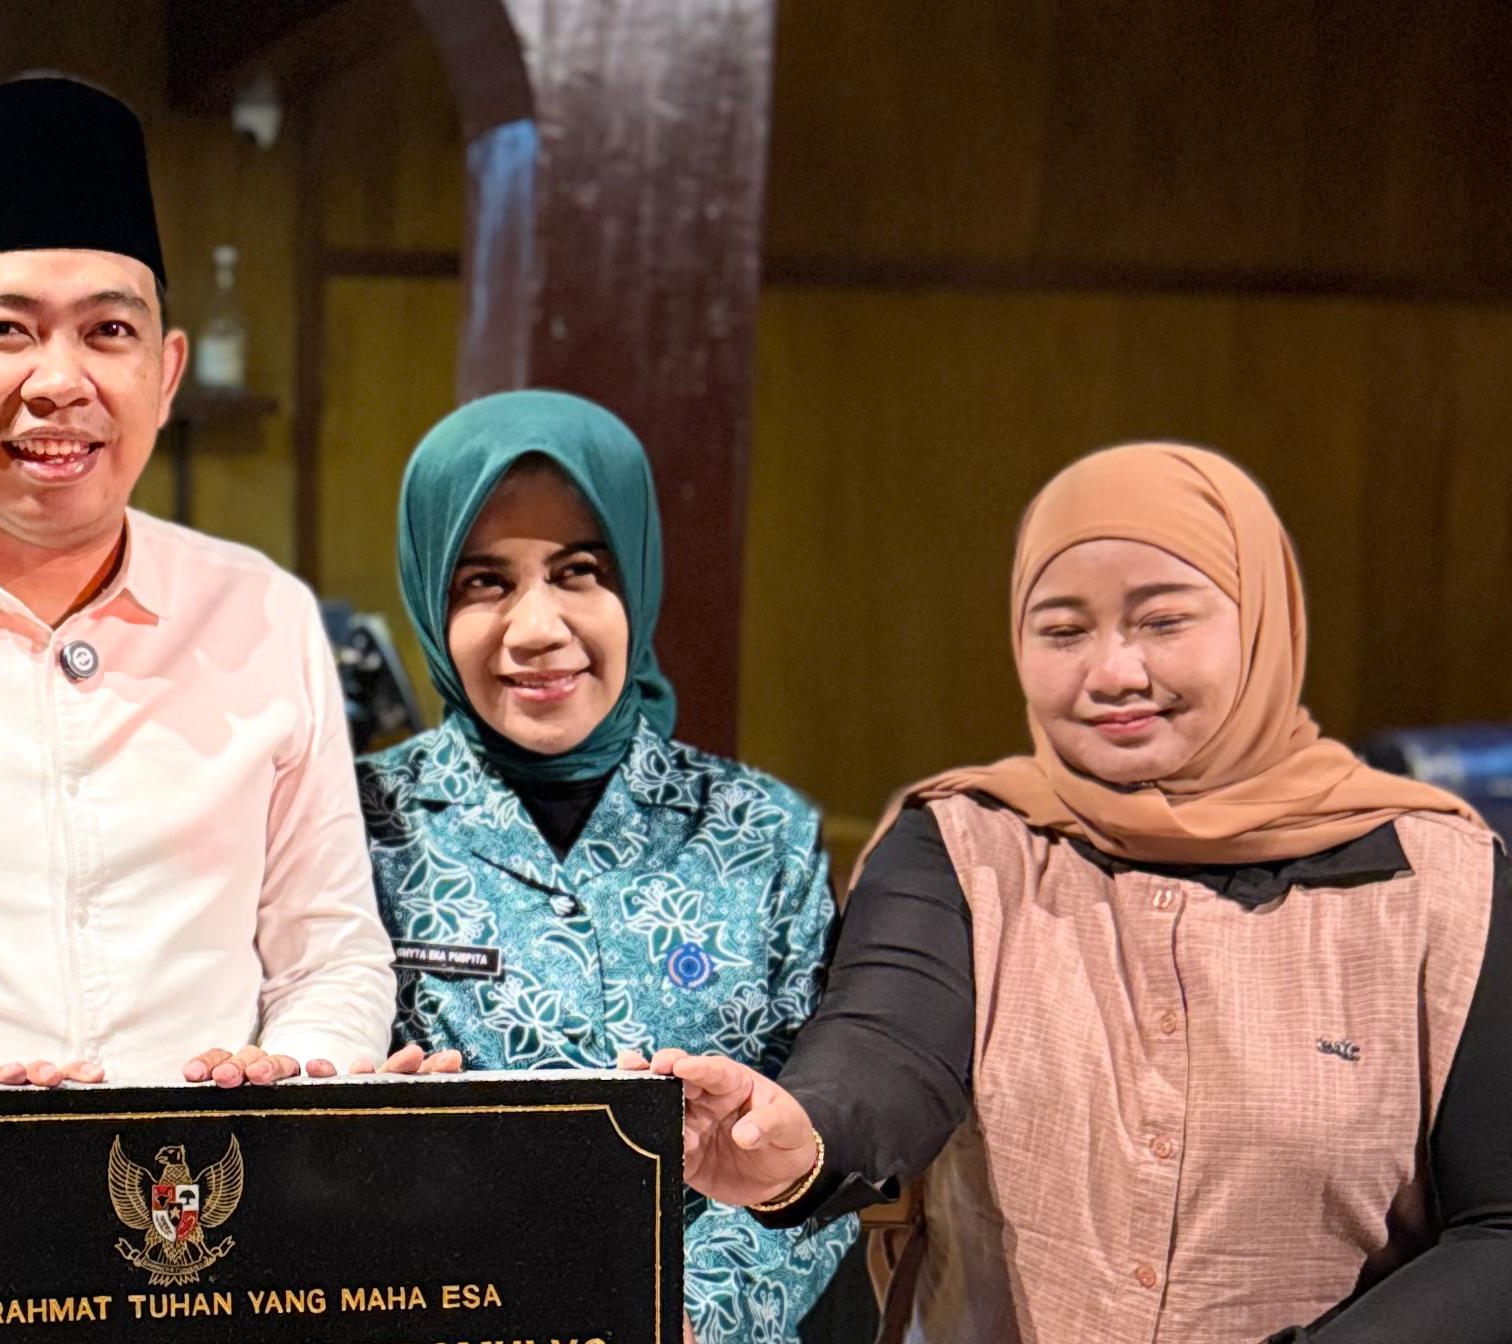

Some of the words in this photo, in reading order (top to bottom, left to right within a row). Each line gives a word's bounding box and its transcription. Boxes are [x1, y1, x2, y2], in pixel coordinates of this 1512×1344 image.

[129, 1293, 232, 1317] TUHAN
[249, 1289, 326, 1313] YANG
[342, 1287, 427, 1311] MAHA
[442, 1284, 500, 1308] ESA
